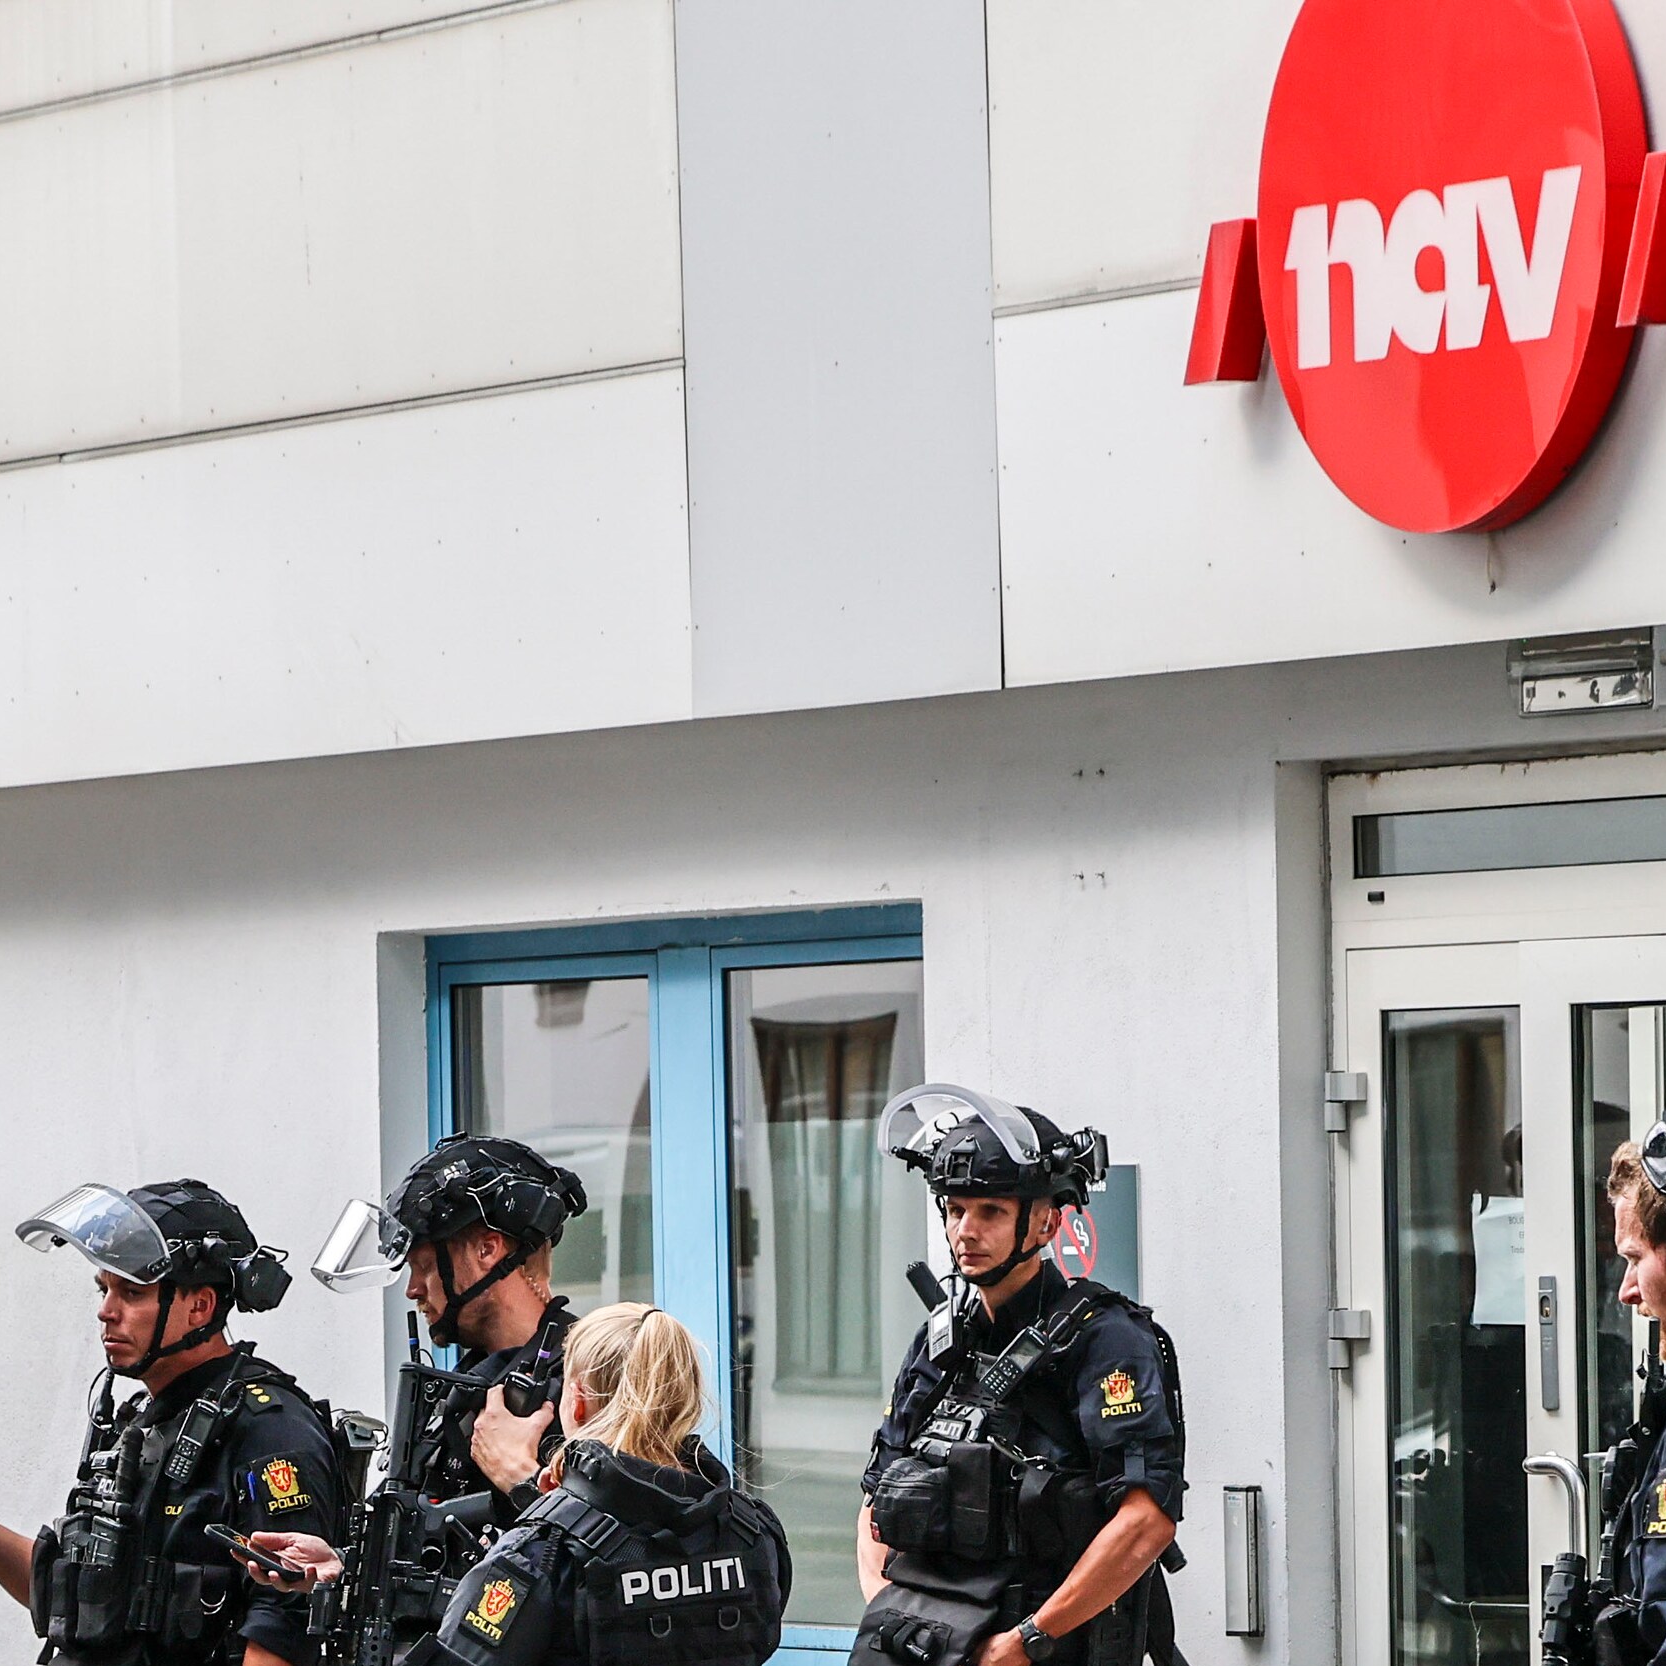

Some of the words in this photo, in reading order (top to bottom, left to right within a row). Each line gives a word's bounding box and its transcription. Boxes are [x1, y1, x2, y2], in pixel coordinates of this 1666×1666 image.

[1284, 165, 1582, 370] nav
[1101, 1402, 1142, 1419] POLITI
[268, 1494, 309, 1512] POLITI
[620, 1556, 746, 1605] POLITI
[465, 1610, 503, 1640] POLITI
